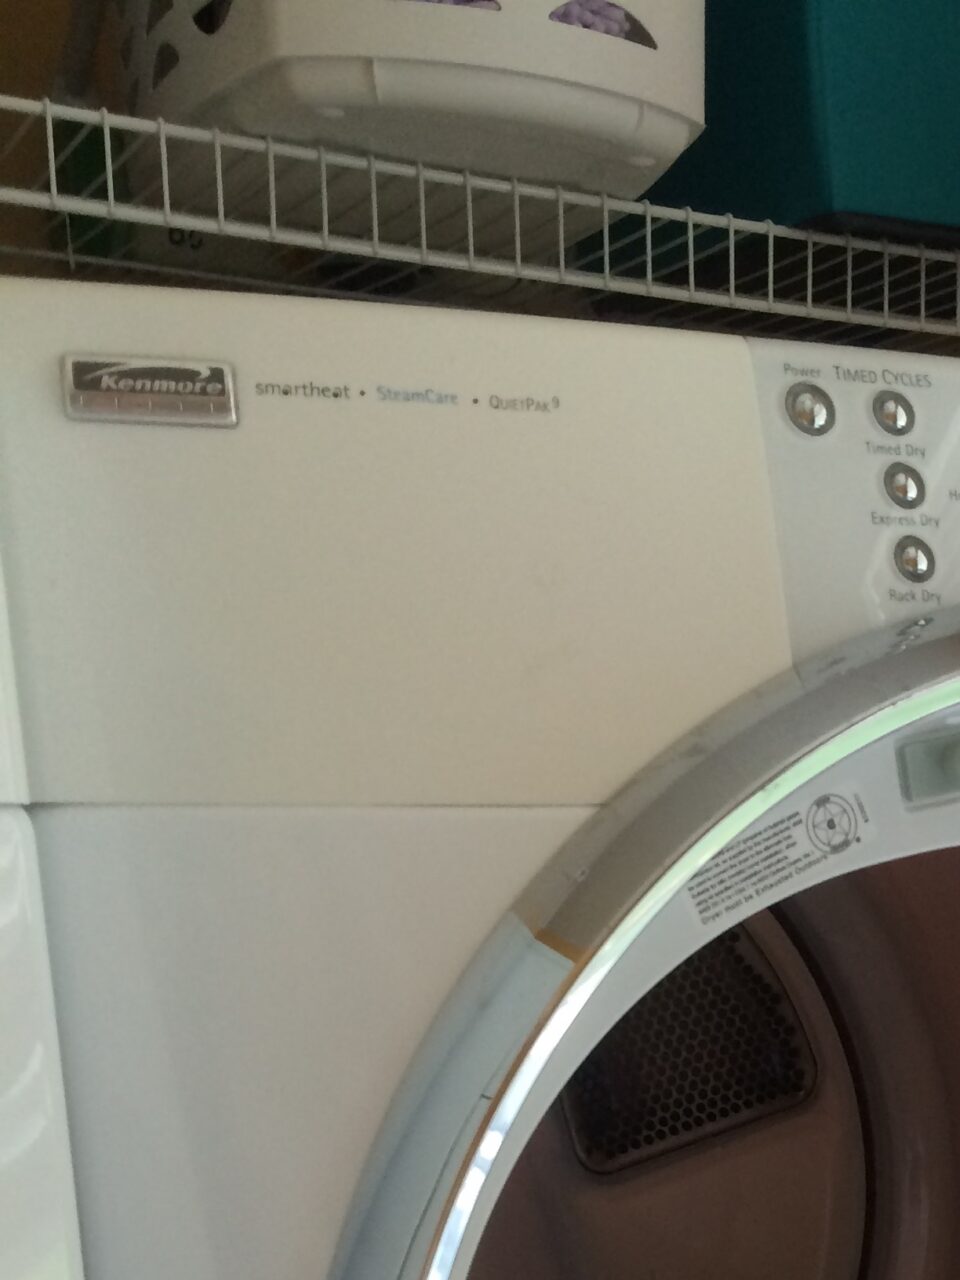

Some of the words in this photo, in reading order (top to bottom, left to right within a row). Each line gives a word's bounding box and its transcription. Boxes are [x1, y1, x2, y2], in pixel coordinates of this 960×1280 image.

[783, 362, 821, 378] Power
[832, 365, 877, 385] TIMED
[881, 369, 932, 388] CYCLES
[100, 375, 222, 395] Kenmore
[254, 380, 350, 399] smartheat
[866, 441, 901, 456] Timed
[905, 444, 926, 458] Dry
[871, 512, 916, 527] Express
[920, 513, 940, 528] Dry
[921, 590, 941, 604] Dry
